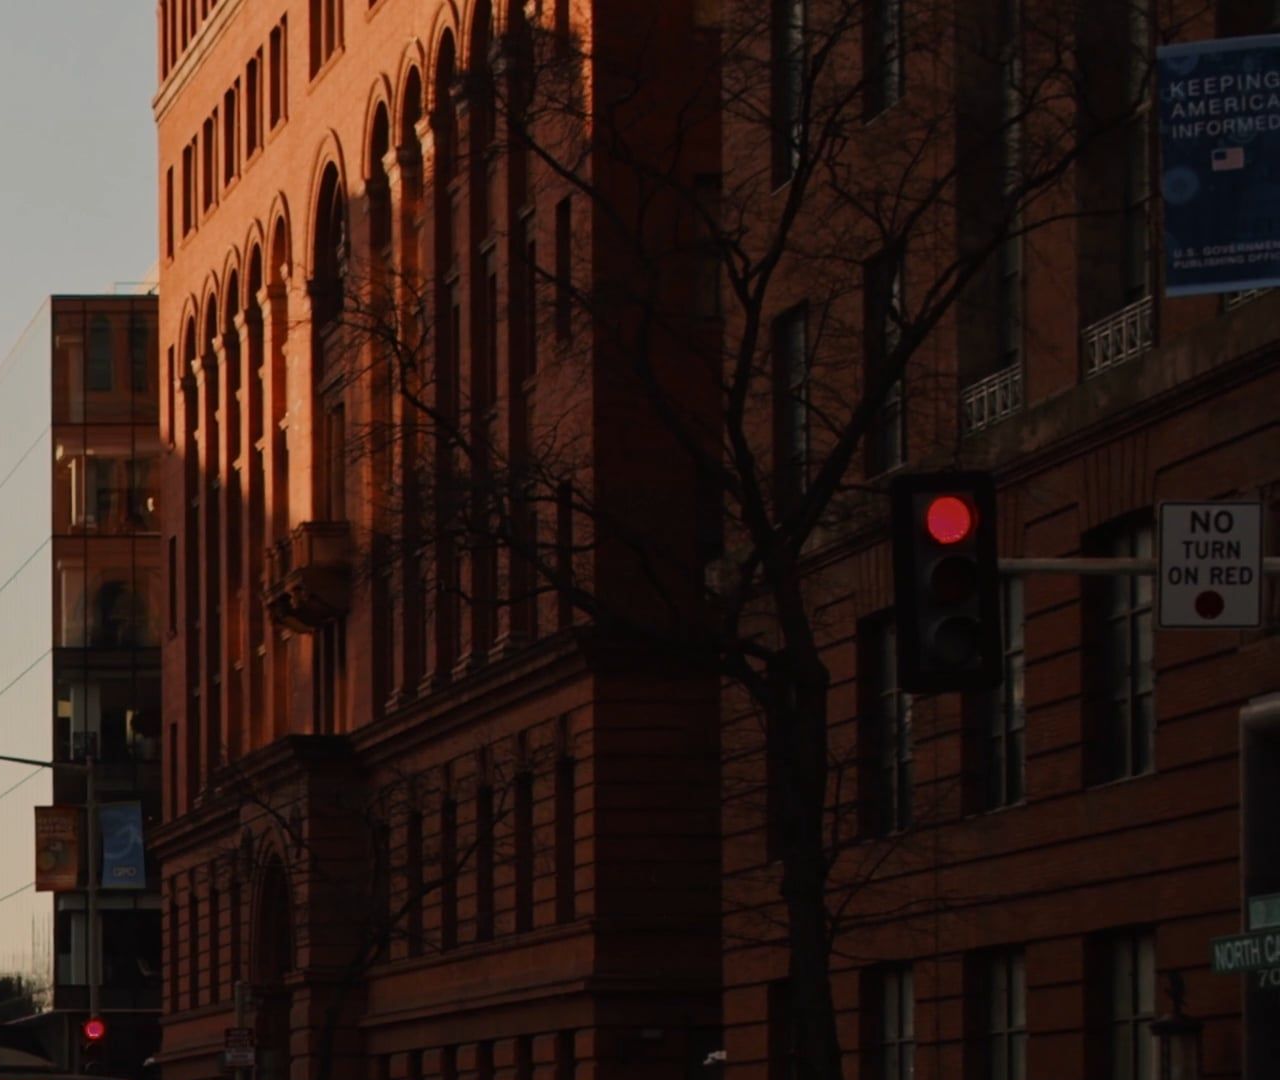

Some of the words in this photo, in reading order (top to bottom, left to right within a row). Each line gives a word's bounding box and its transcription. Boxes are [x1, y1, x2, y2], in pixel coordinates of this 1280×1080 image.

[1170, 71, 1280, 98] KEEPING
[1170, 92, 1280, 120] AMERICA
[1171, 113, 1280, 139] INFORMED
[1190, 510, 1234, 533] NO
[1182, 541, 1241, 559] TURN
[1168, 566, 1199, 585] ON
[1210, 566, 1253, 585] RED
[1214, 937, 1260, 971] NORTH
